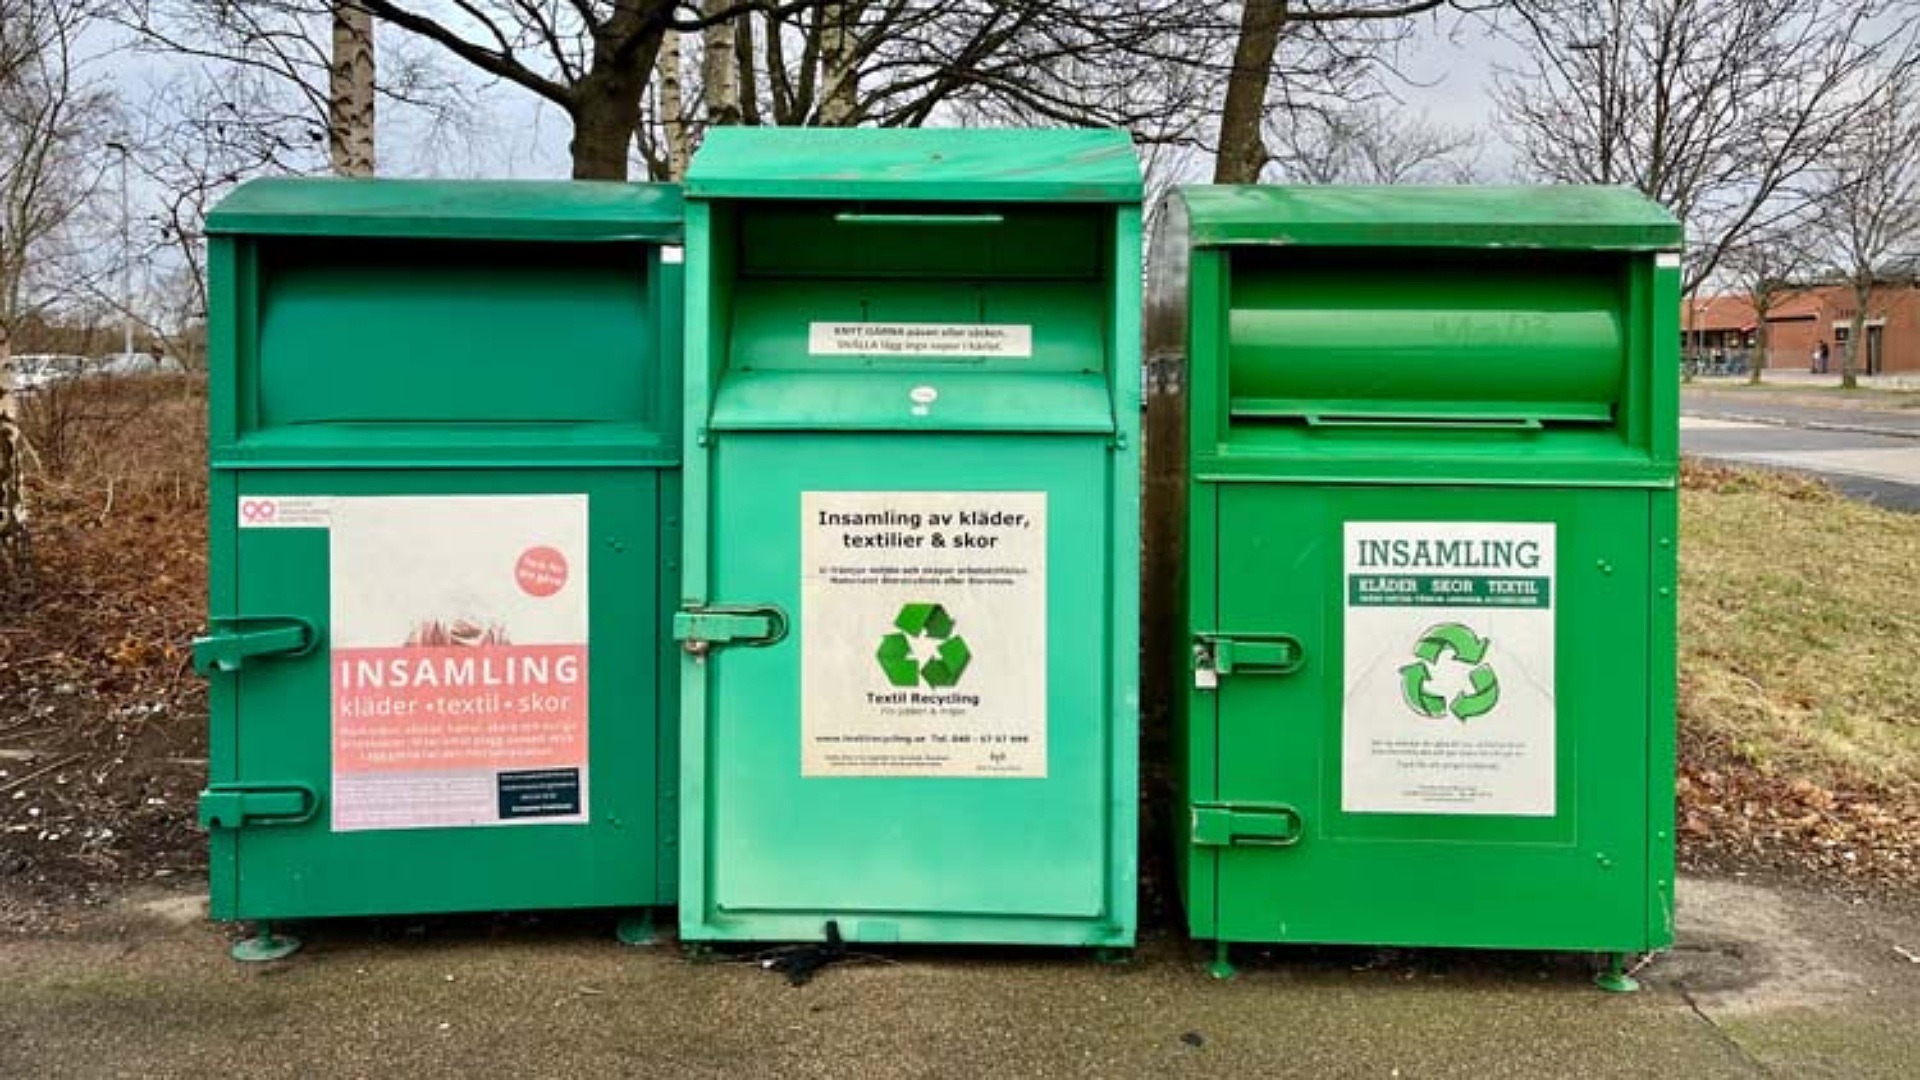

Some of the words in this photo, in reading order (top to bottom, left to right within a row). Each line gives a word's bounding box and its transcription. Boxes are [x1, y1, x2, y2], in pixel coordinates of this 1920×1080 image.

[818, 511, 921, 529] Insamling
[928, 514, 953, 526] av
[958, 511, 1030, 528] kläder,
[843, 532, 925, 548] textilier
[930, 533, 946, 548] &
[953, 532, 999, 548] skor
[1358, 540, 1541, 568] INSAMLING
[341, 654, 578, 689] INSAMLING
[340, 695, 418, 717] kläder
[517, 692, 571, 713] skor
[867, 692, 907, 704] Textil
[911, 692, 980, 706] Recycling
